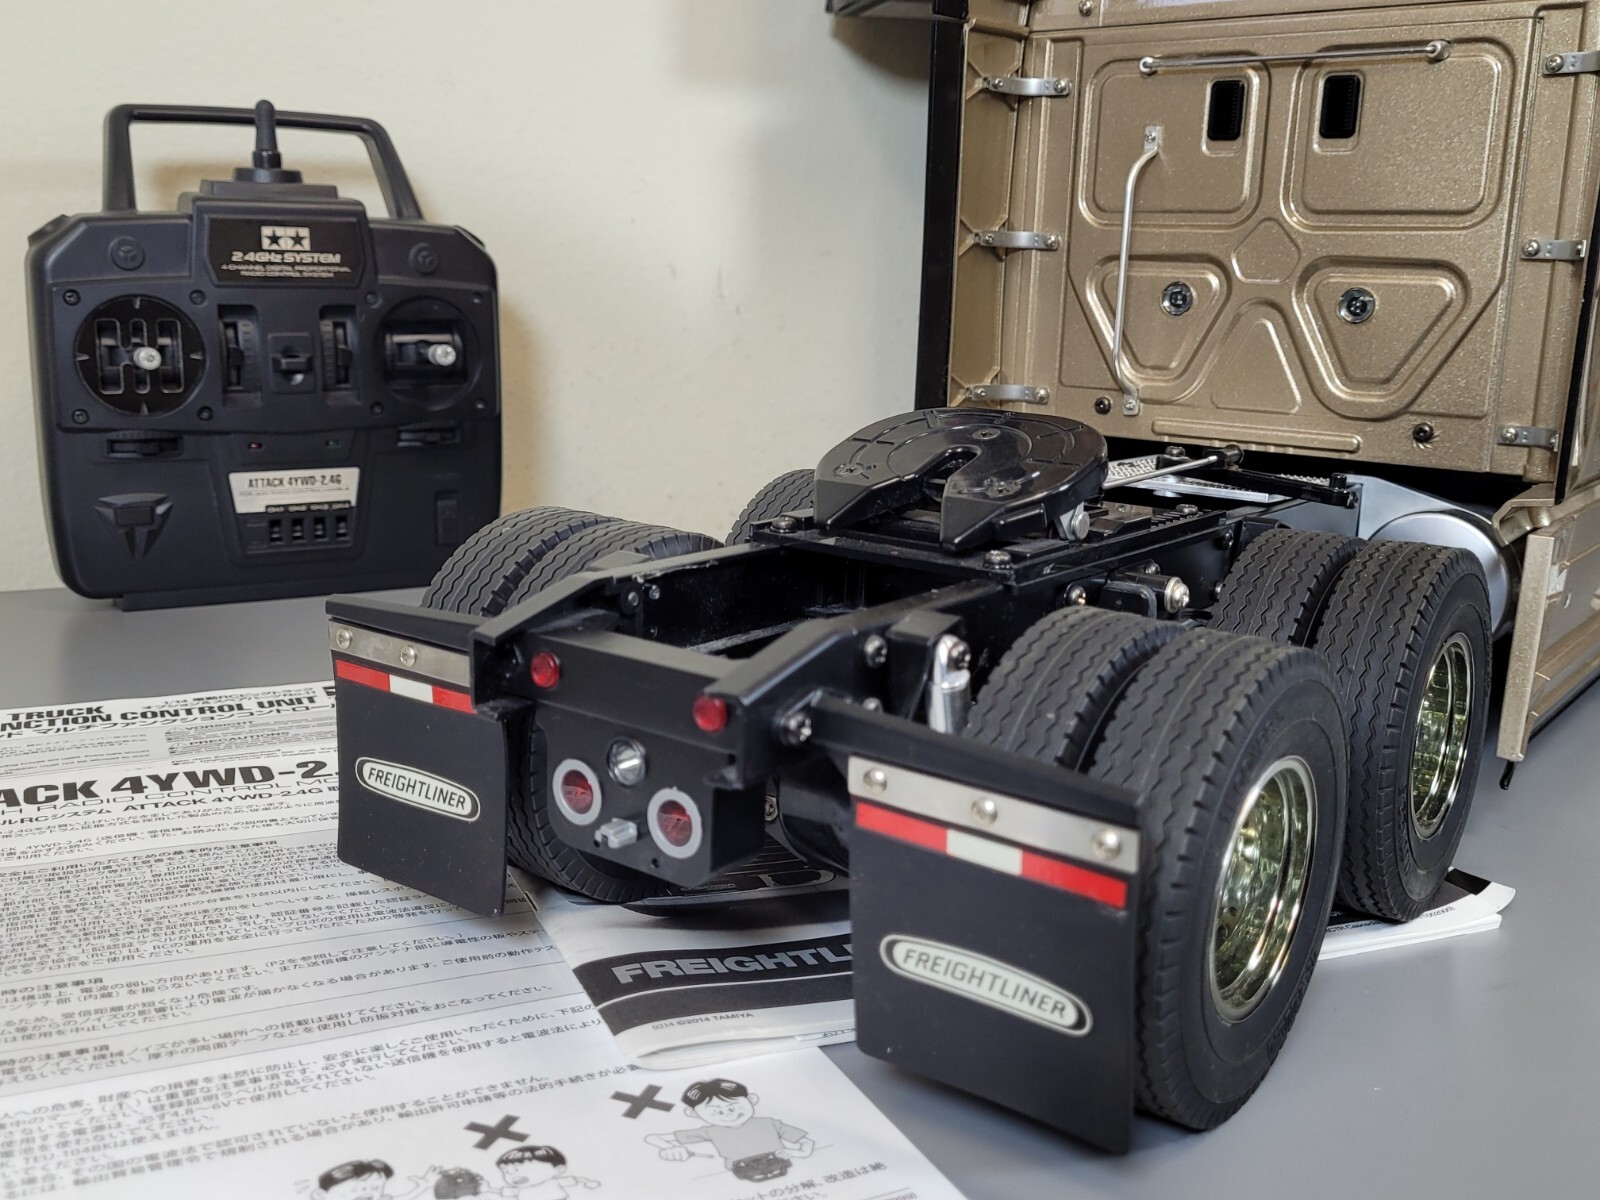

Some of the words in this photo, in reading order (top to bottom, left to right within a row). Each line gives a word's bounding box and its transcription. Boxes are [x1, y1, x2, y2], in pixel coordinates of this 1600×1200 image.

[283, 252, 341, 263] SYSTEM
[248, 478, 284, 488] ATTACK
[0, 714, 112, 731] NCTION
[120, 703, 251, 720] CONTROL
[256, 696, 318, 708] UNIT
[7, 706, 104, 721] TRUCK
[32, 703, 335, 734] マルチファンクションコントロー
[37, 796, 134, 811] RADIO
[145, 784, 291, 800] CONTROL
[123, 798, 208, 811] ATTACK
[216, 787, 325, 802] 4YWD-2.4G
[368, 767, 466, 810] FREIGHTLINER
[902, 948, 1067, 1019] FREIGHTLINER
[712, 1012, 754, 1021] TAMIYA
